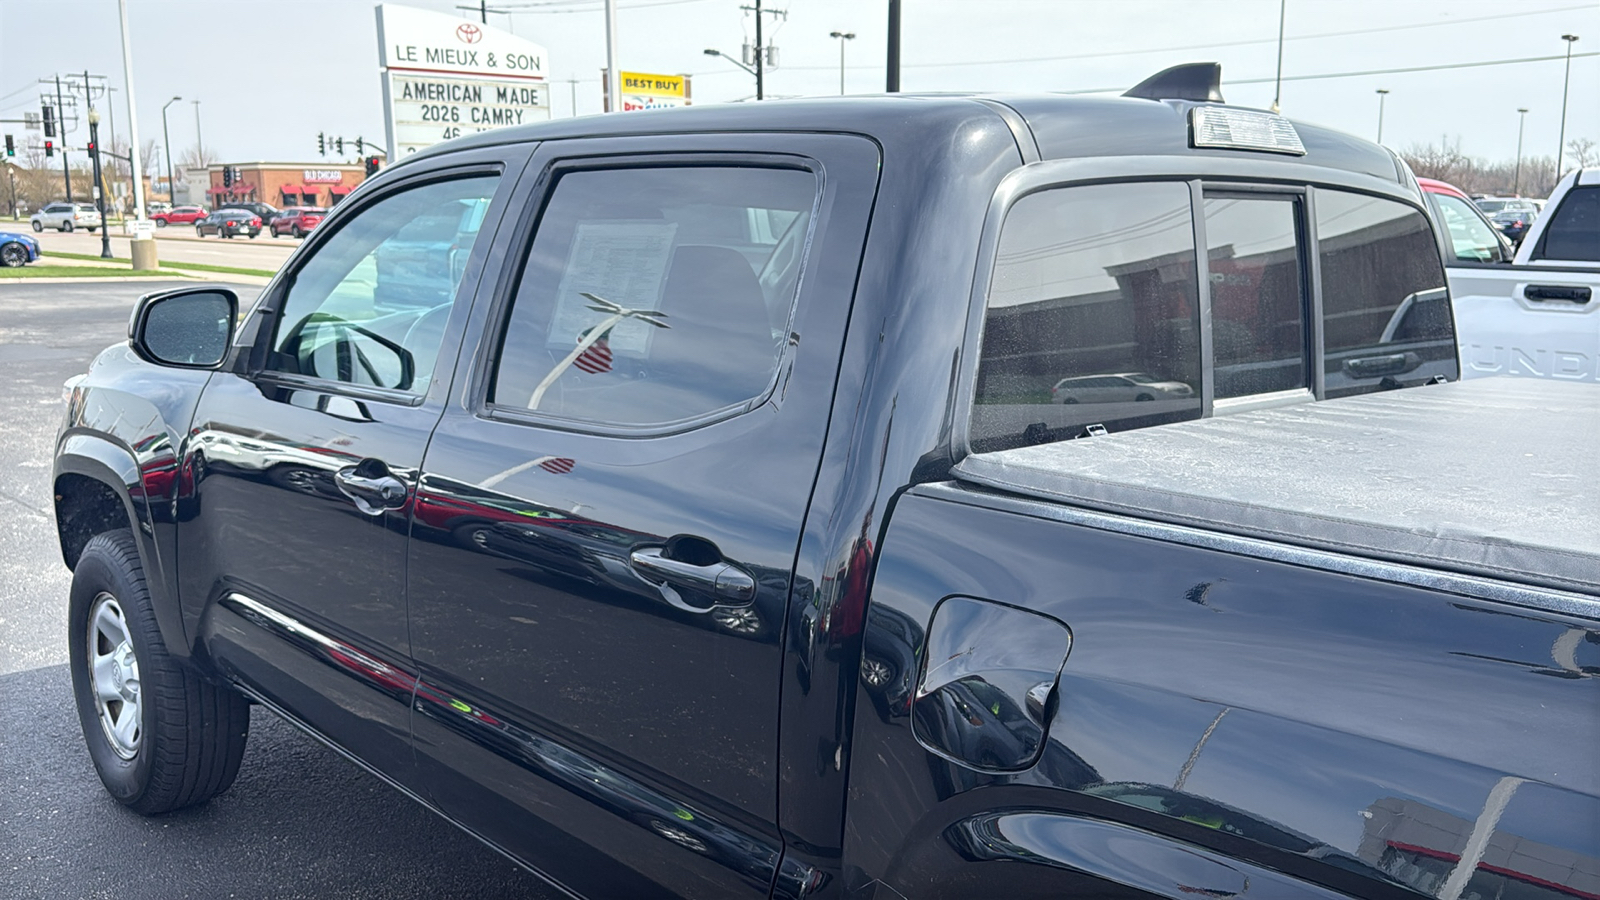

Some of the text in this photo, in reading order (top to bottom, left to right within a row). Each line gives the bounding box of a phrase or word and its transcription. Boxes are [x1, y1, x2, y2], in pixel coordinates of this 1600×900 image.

[396, 45, 541, 71] LE MIEUX & SON
[402, 82, 539, 106] AMERICAN MADE
[625, 78, 680, 91] BEST BUY
[421, 104, 524, 125] 2026 CAMRY
